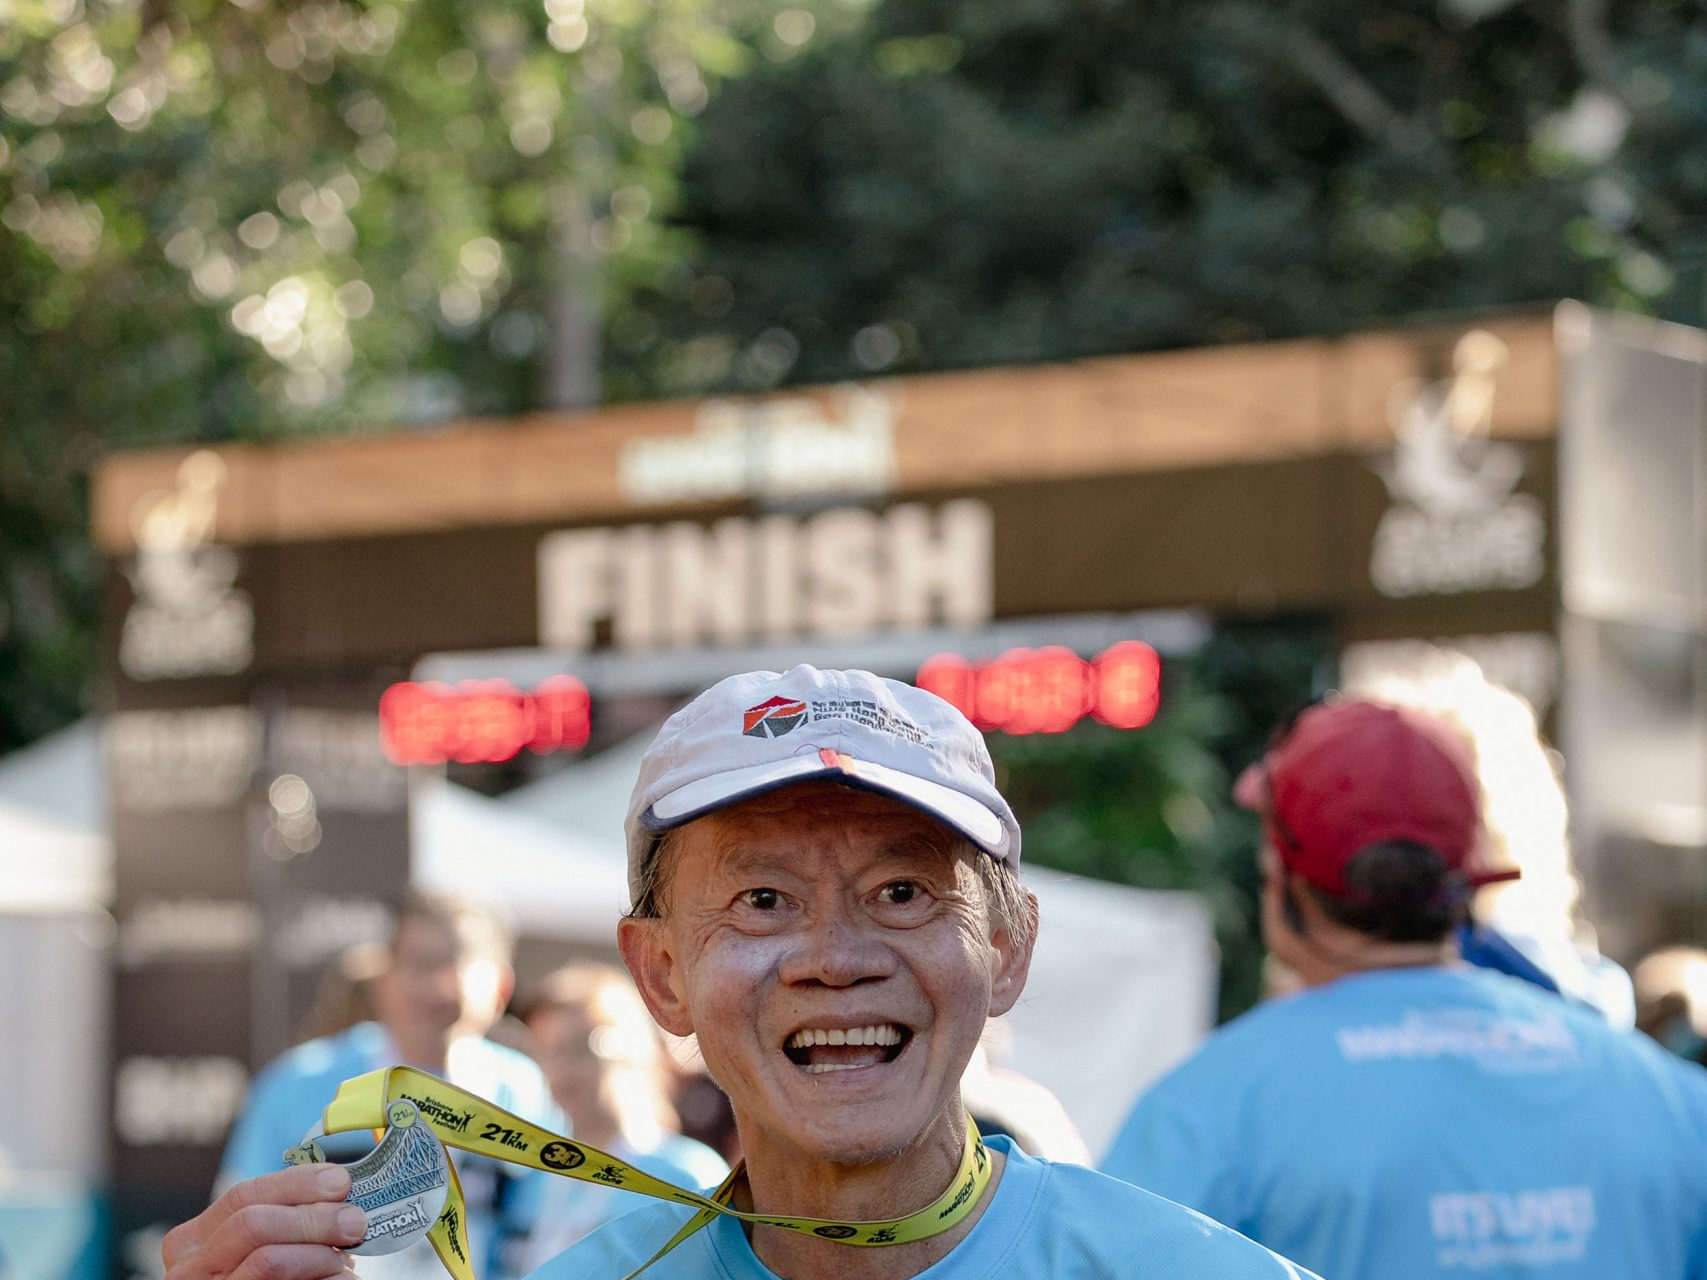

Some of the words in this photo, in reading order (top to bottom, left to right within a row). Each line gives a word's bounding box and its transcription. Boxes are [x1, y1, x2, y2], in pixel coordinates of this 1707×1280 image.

[536, 498, 994, 650] FINISH
[425, 1096, 453, 1112] Brisbane
[432, 1117, 458, 1131] Festival
[365, 1210, 418, 1240] RATHON
